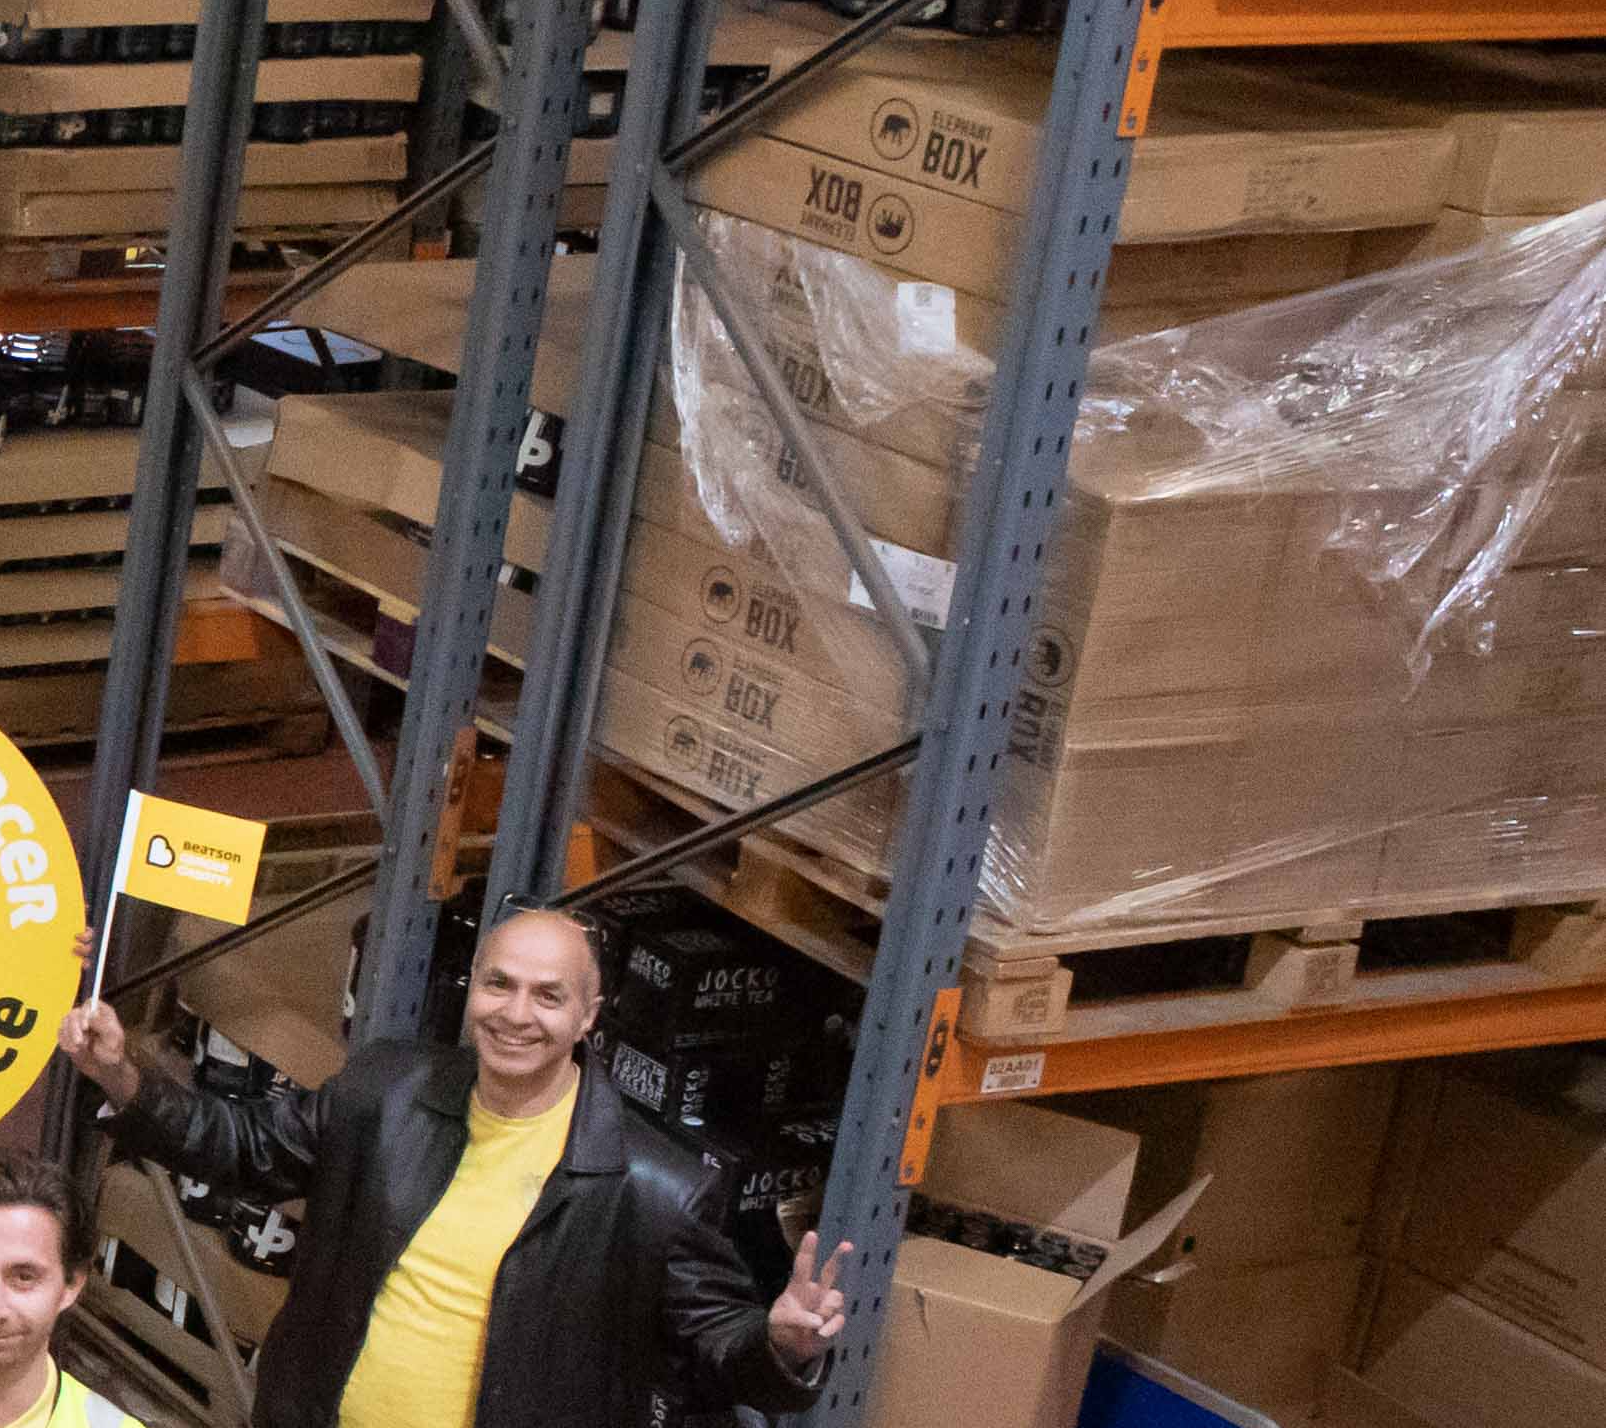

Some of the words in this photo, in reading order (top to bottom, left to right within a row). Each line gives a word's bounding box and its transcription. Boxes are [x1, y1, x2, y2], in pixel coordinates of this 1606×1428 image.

[933, 110, 993, 143] ELEPHANT
[923, 132, 988, 189] BOX
[805, 168, 863, 222] BOX
[745, 599, 800, 653] BOX
[724, 676, 780, 731] BOX
[693, 990, 740, 1009] WHITE
[746, 988, 775, 1006] TEA
[698, 968, 779, 993] JOCKO
[682, 1069, 701, 1121] JOCKO
